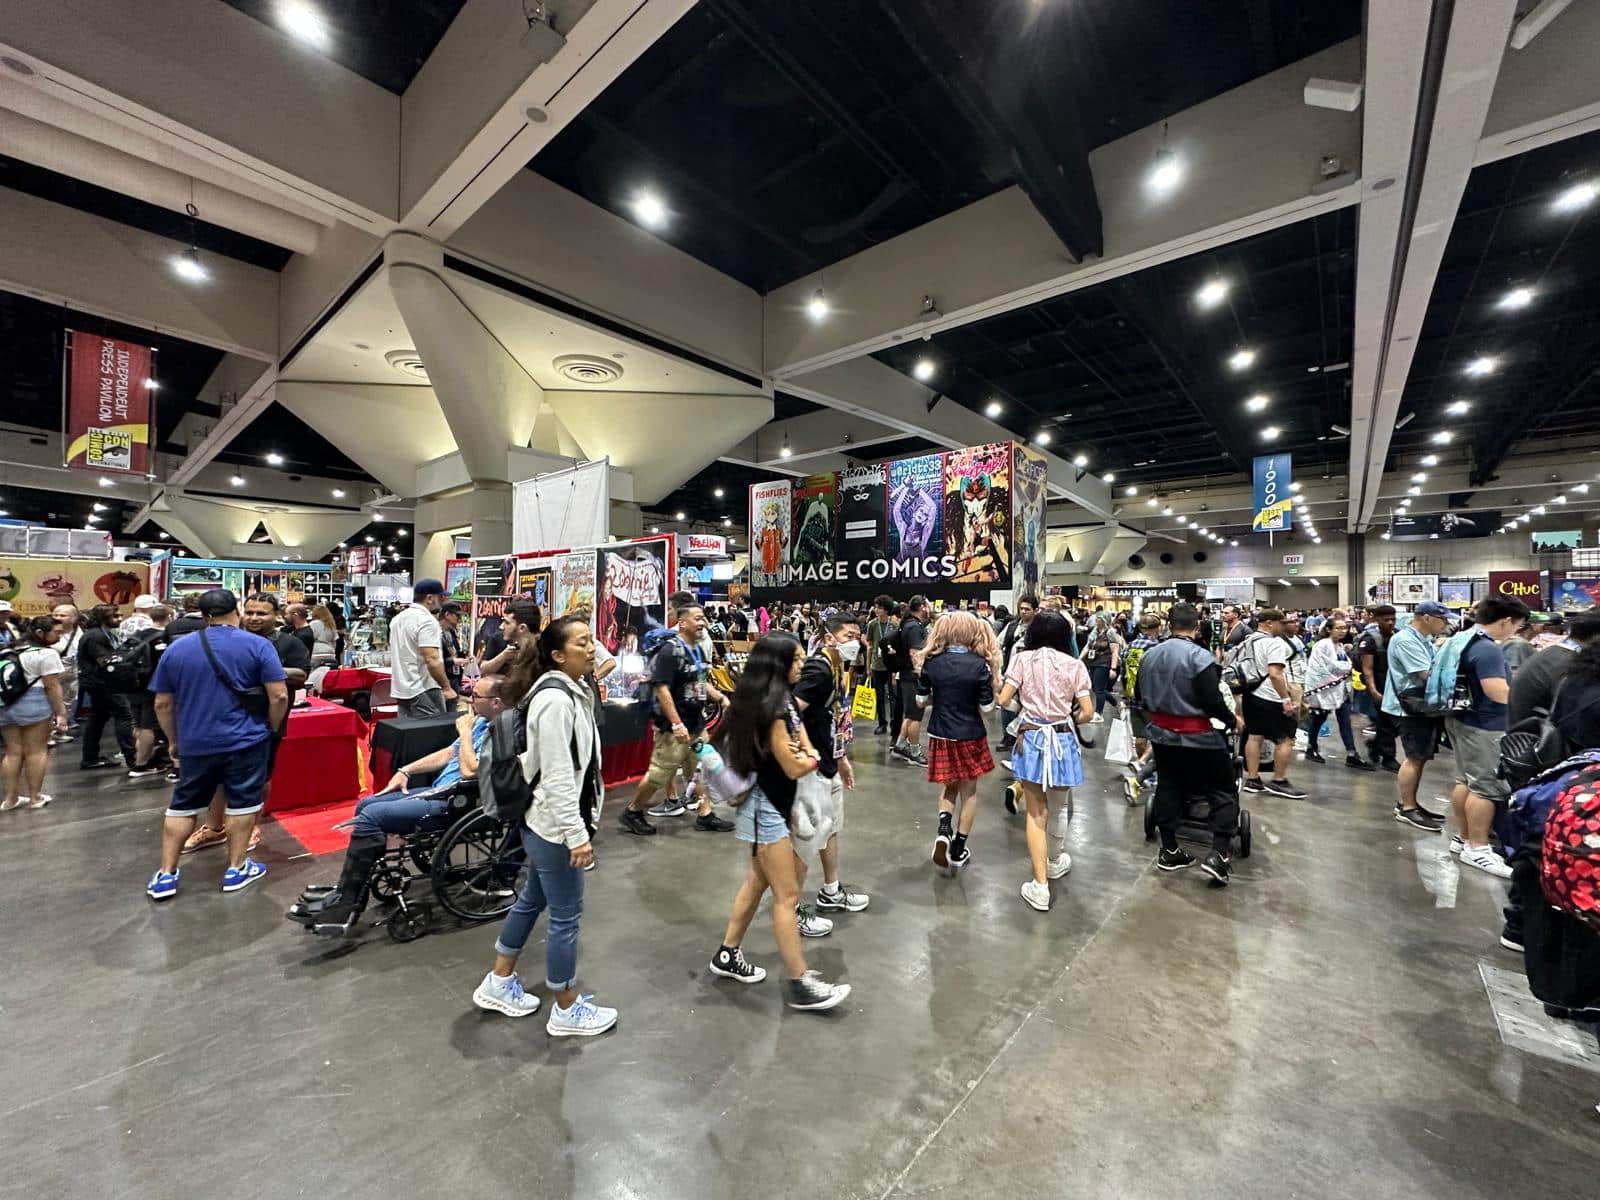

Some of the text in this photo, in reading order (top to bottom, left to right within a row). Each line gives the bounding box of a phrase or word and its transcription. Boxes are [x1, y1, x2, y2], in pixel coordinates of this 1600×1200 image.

[99, 340, 115, 422] PRESS PAVILION
[115, 350, 130, 421] INDEPENDENT
[89, 432, 104, 461] COMIC
[104, 435, 129, 447] CON
[755, 488, 788, 499] FISHFLIES
[1264, 458, 1277, 505] 1900
[782, 555, 957, 582] IMAGE COMICS
